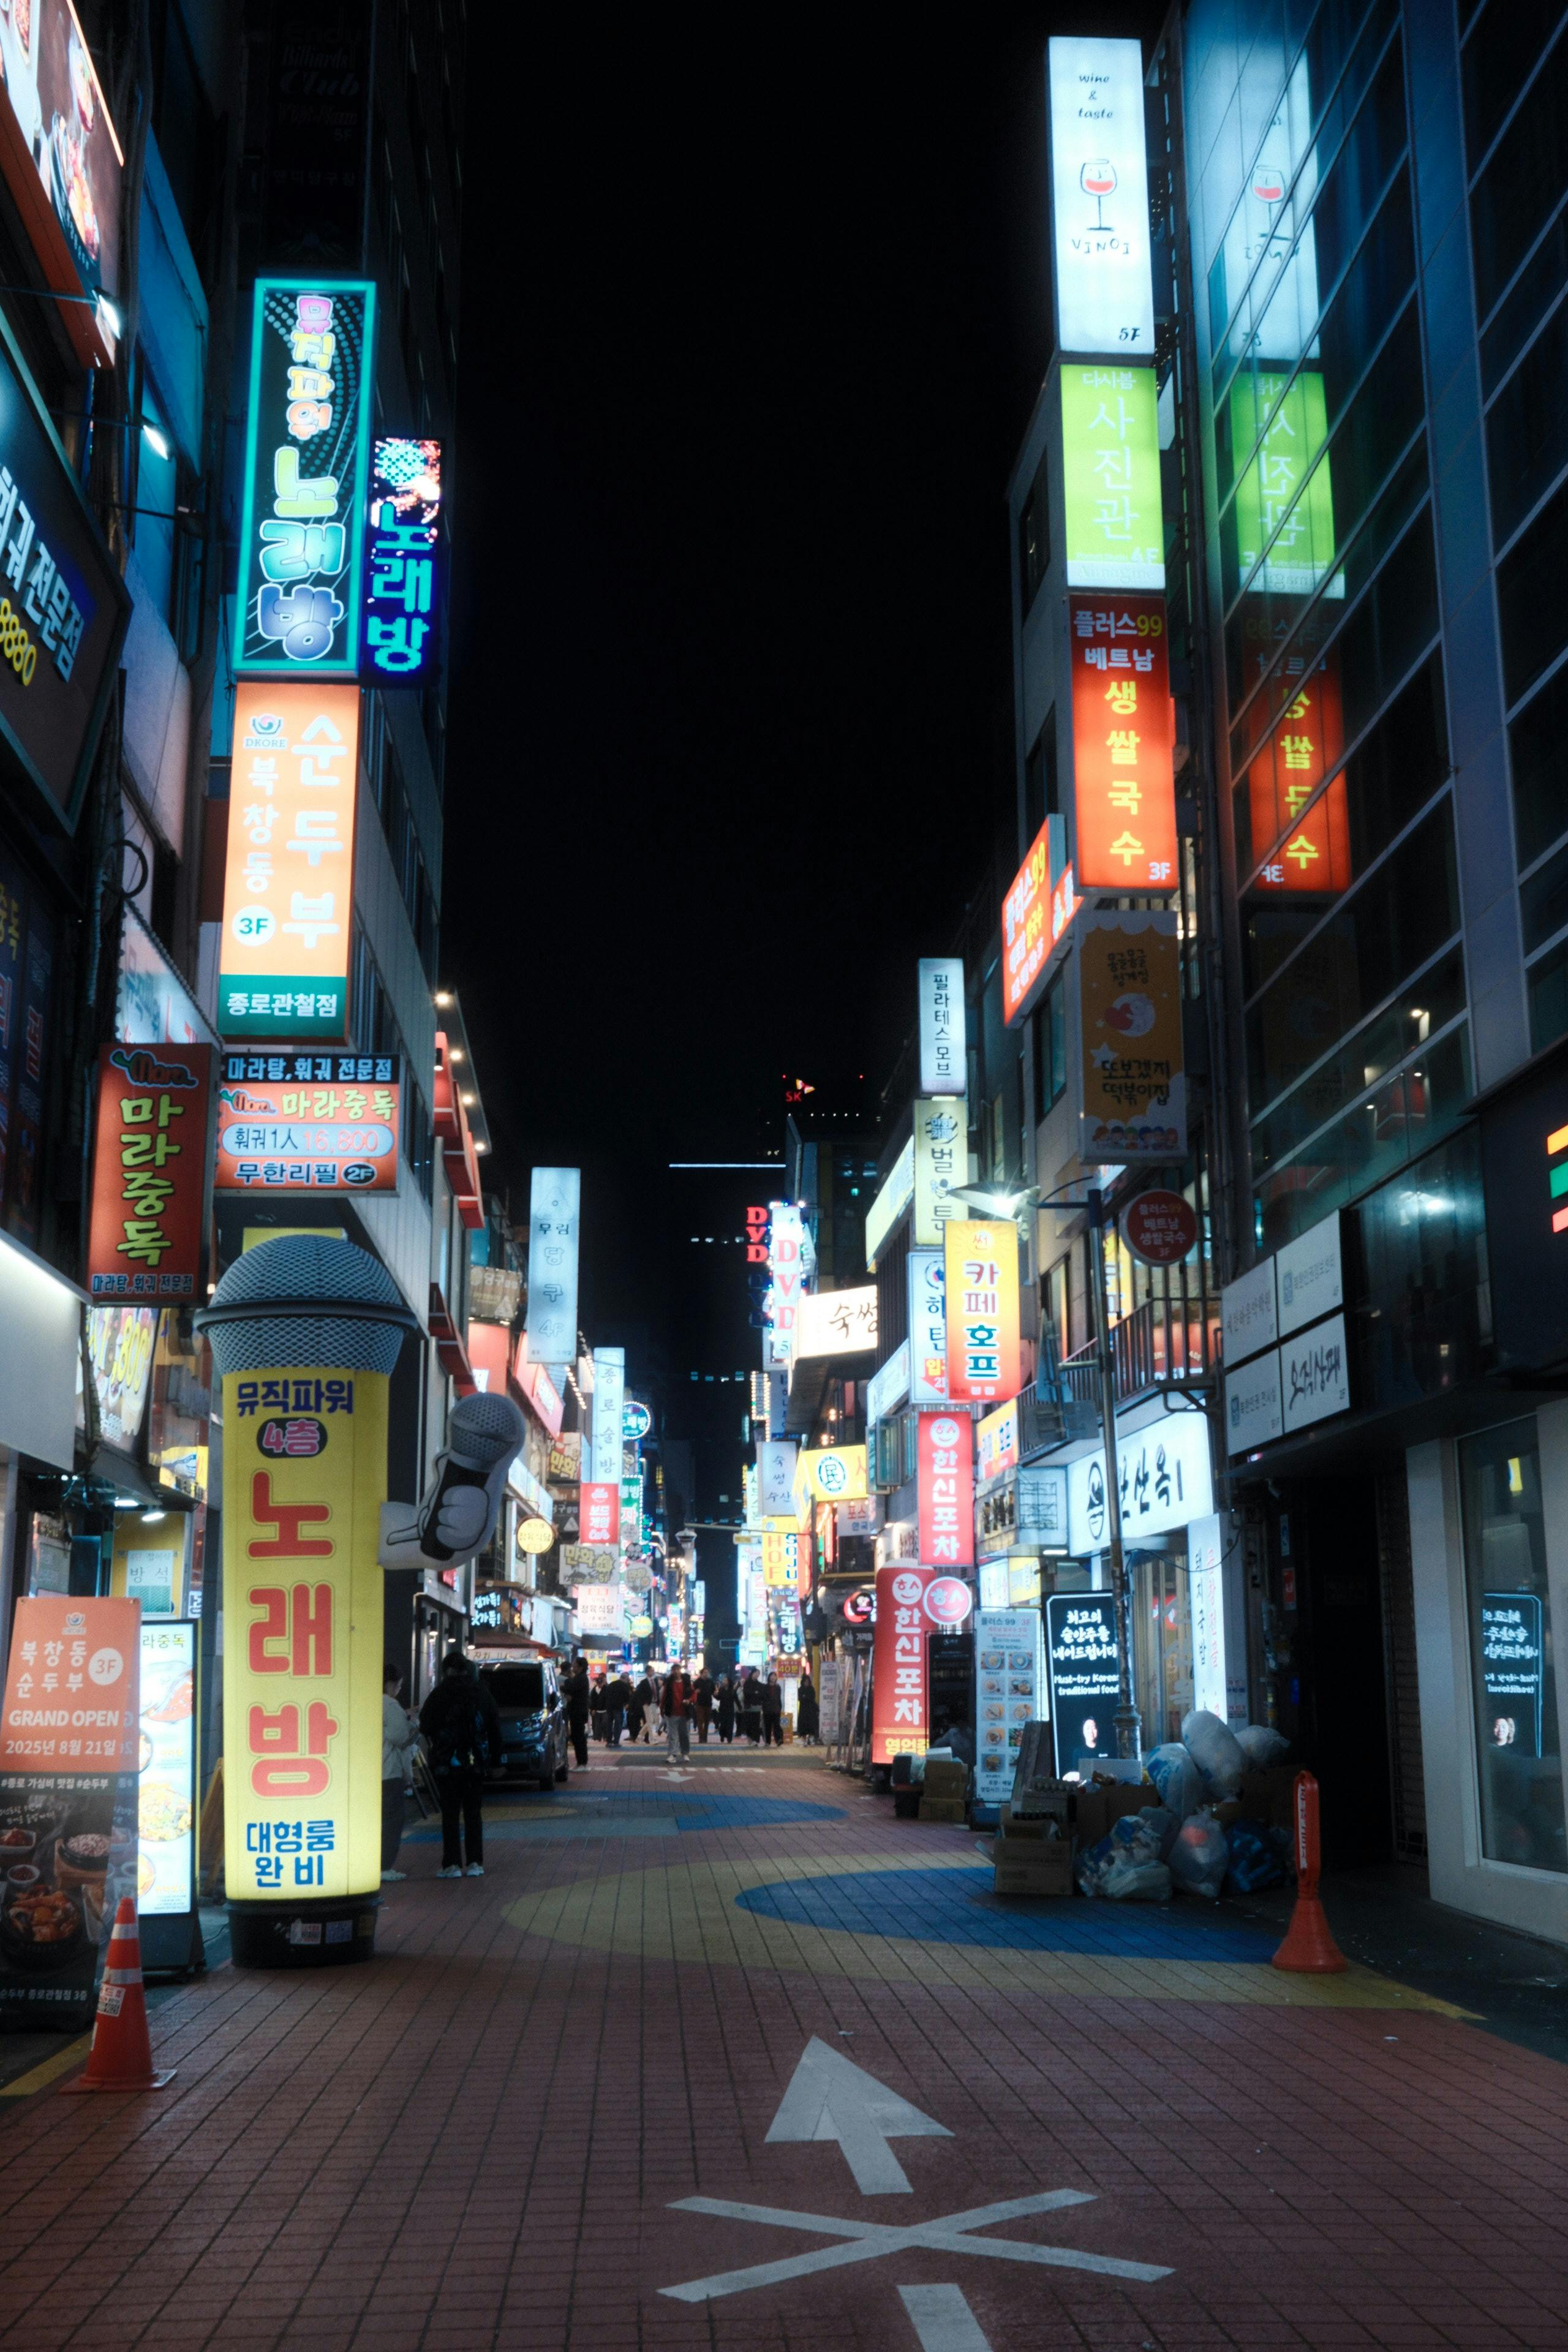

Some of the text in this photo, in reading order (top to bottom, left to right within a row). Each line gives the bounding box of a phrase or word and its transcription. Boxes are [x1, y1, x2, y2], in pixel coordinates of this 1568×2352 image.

[1078, 74, 1110, 84] wine
[1088, 90, 1098, 101] &
[1077, 107, 1114, 119] taste
[1118, 326, 1142, 341] 5F
[1088, 395, 1140, 541] 사진관
[257, 446, 347, 662] 노래방
[368, 501, 434, 672] 노래방
[1074, 610, 1163, 638] 플러스99
[1084, 647, 1155, 672] 베트남
[246, 739, 287, 748] DKORE
[1104, 680, 1145, 866] 생쌀국수
[242, 757, 279, 893] 북창동
[281, 715, 349, 949] 순두부
[1148, 862, 1171, 881] 3F
[238, 917, 269, 935] 3F
[227, 992, 337, 1019] 종로관철점
[933, 974, 951, 1041] 필라테스
[227, 1057, 393, 1082] 마라탕,훠궈 전문점
[935, 1046, 952, 1076] 모브
[281, 1089, 397, 1121] 마라중독
[785, 1091, 802, 1102] SK
[303, 1128, 379, 1154] 16,800
[116, 1093, 184, 1267] 마라중독
[235, 1163, 337, 1185] 무한리필
[347, 1167, 373, 1182] 2F
[746, 1207, 769, 1263] DVD
[159, 1274, 194, 1294] 전문점
[543, 1246, 564, 1303] 당구
[777, 1239, 799, 1330] DVD
[963, 1262, 1000, 1314] 카페
[964, 1324, 999, 1378] 호프
[237, 1379, 354, 1417] 뮤직파워
[263, 1419, 320, 1456] 4층
[931, 1449, 960, 1560] 한신포차
[564, 1544, 596, 1568] 만화
[767, 1534, 782, 1580] HOF
[785, 1533, 797, 1580] SOJU
[778, 1600, 798, 1653] 노래방
[1066, 1608, 1102, 1624] 최고의
[247, 1470, 339, 1798] 노래방
[1060, 1624, 1110, 1644] 술안주를
[20, 1640, 87, 1667] 북창동
[96, 1659, 117, 1674] 3F
[894, 1607, 923, 1725] 한신포차
[16, 1672, 84, 1699] 순두부
[1054, 1674, 1091, 1684] Must-try
[1058, 1685, 1100, 1696] traditional
[9, 1709, 119, 1727] GRAND OPEN
[6, 1738, 116, 1756] 2025년 8월 21일
[28, 1777, 55, 1789] 가심비
[56, 1777, 75, 1790] 맛집
[246, 1819, 336, 1853] 대형룸
[254, 1854, 325, 1888] 완비
